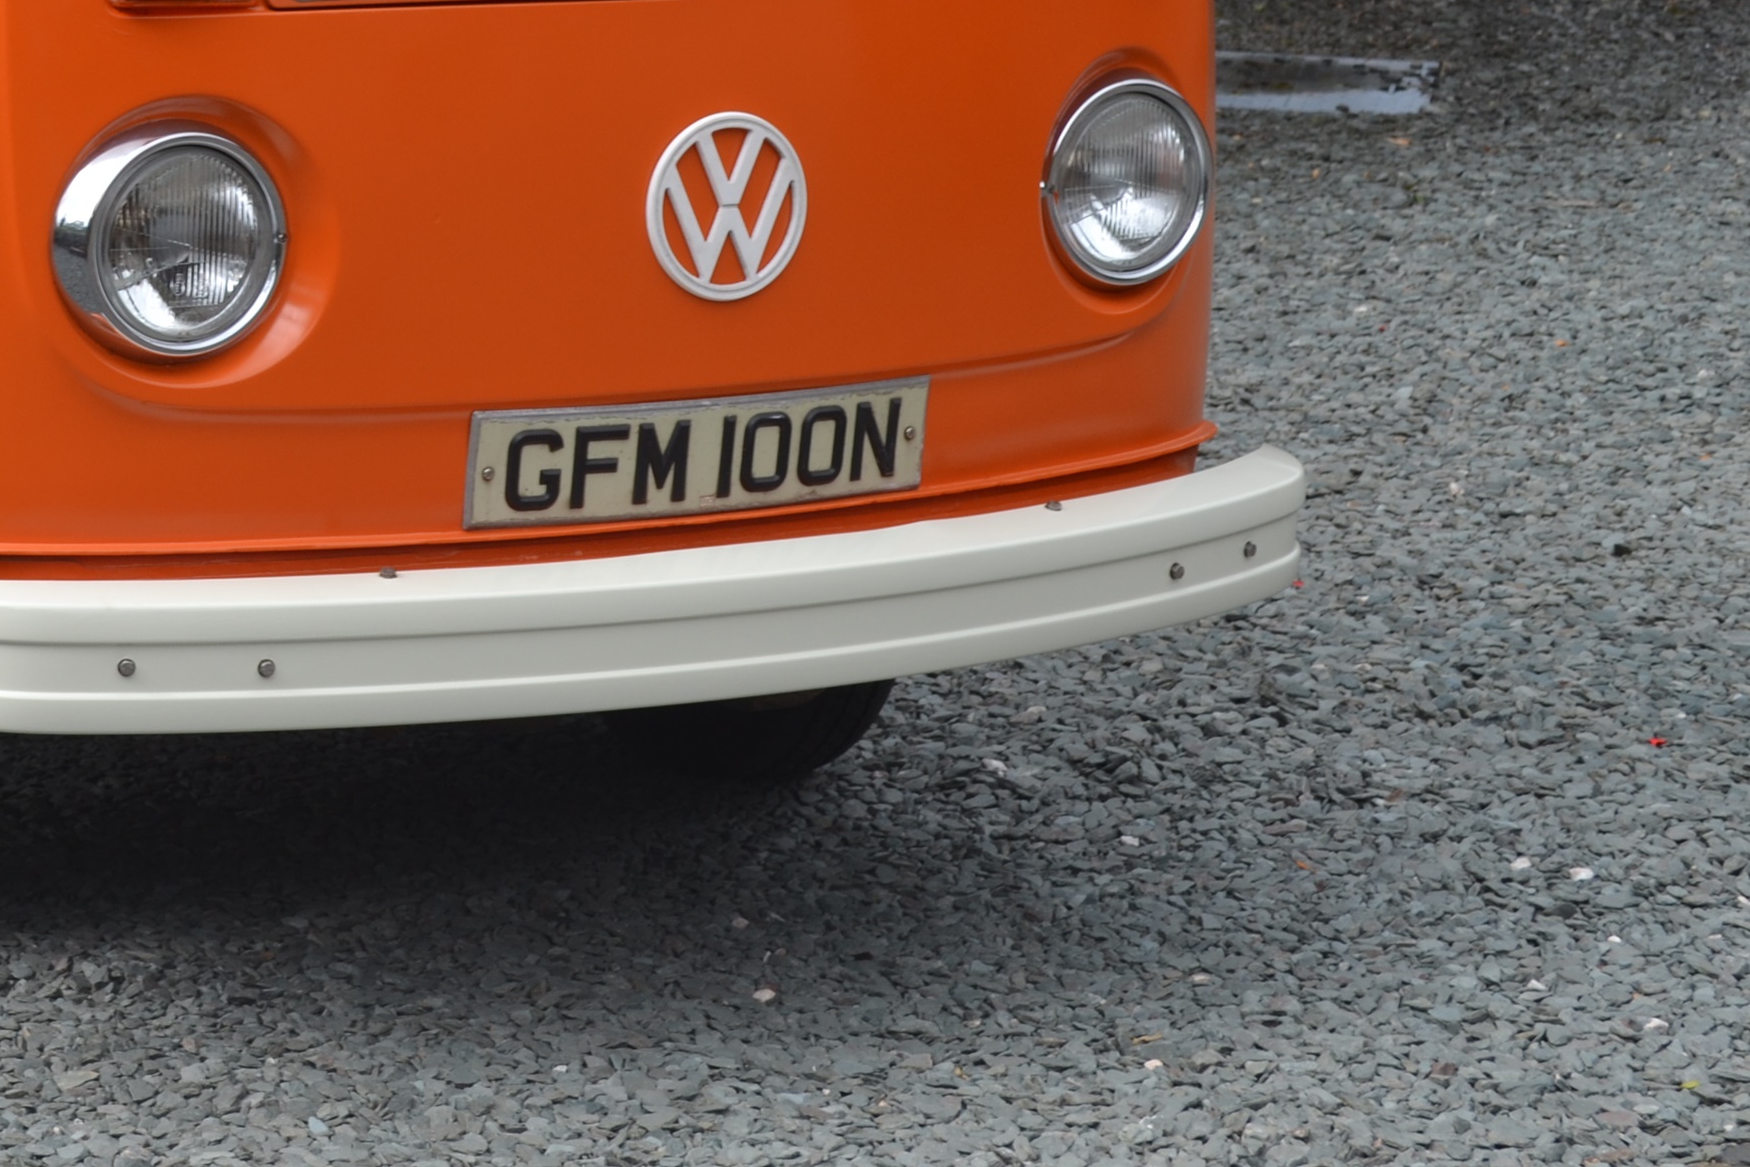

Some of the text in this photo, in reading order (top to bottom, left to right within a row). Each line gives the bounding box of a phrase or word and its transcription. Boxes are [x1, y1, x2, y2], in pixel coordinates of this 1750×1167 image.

[650, 116, 803, 296] VW
[503, 397, 903, 513] GFM 100N
